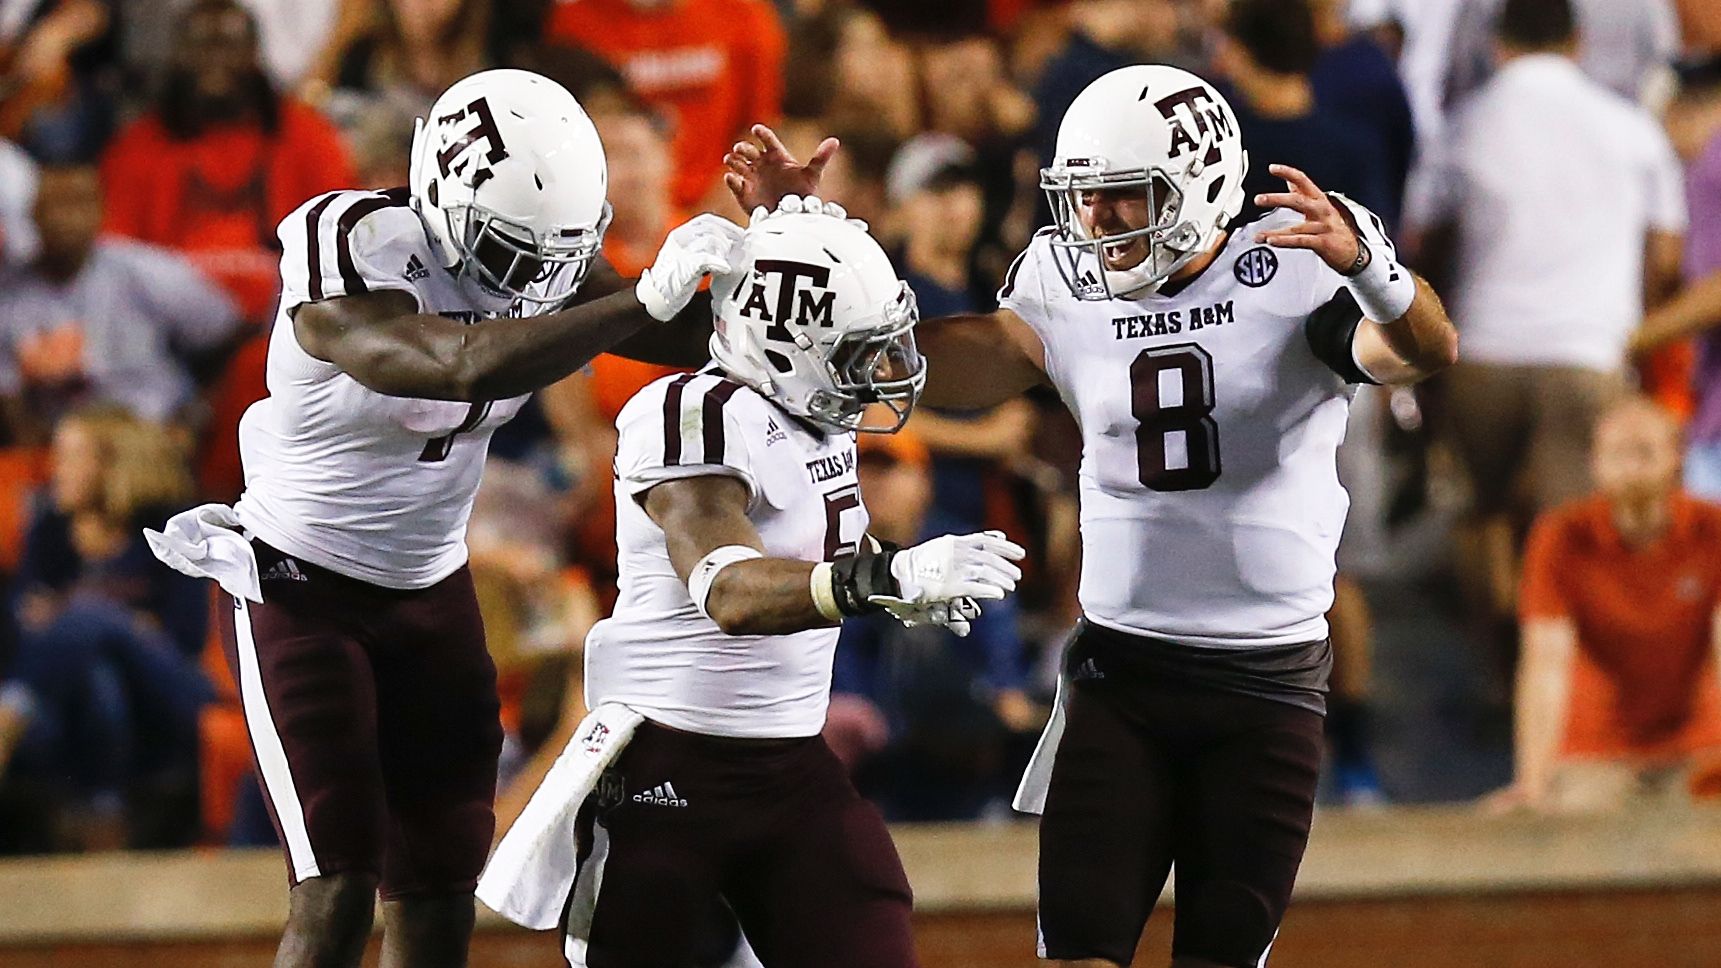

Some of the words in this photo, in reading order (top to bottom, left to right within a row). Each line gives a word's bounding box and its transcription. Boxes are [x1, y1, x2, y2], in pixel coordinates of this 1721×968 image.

[1239, 251, 1274, 285] SEC
[1112, 311, 1182, 340] TEXAS
[1189, 300, 1235, 331] A&M
[1130, 342, 1222, 491] 8
[806, 457, 844, 484] TEXAS
[632, 794, 688, 807] adidas
